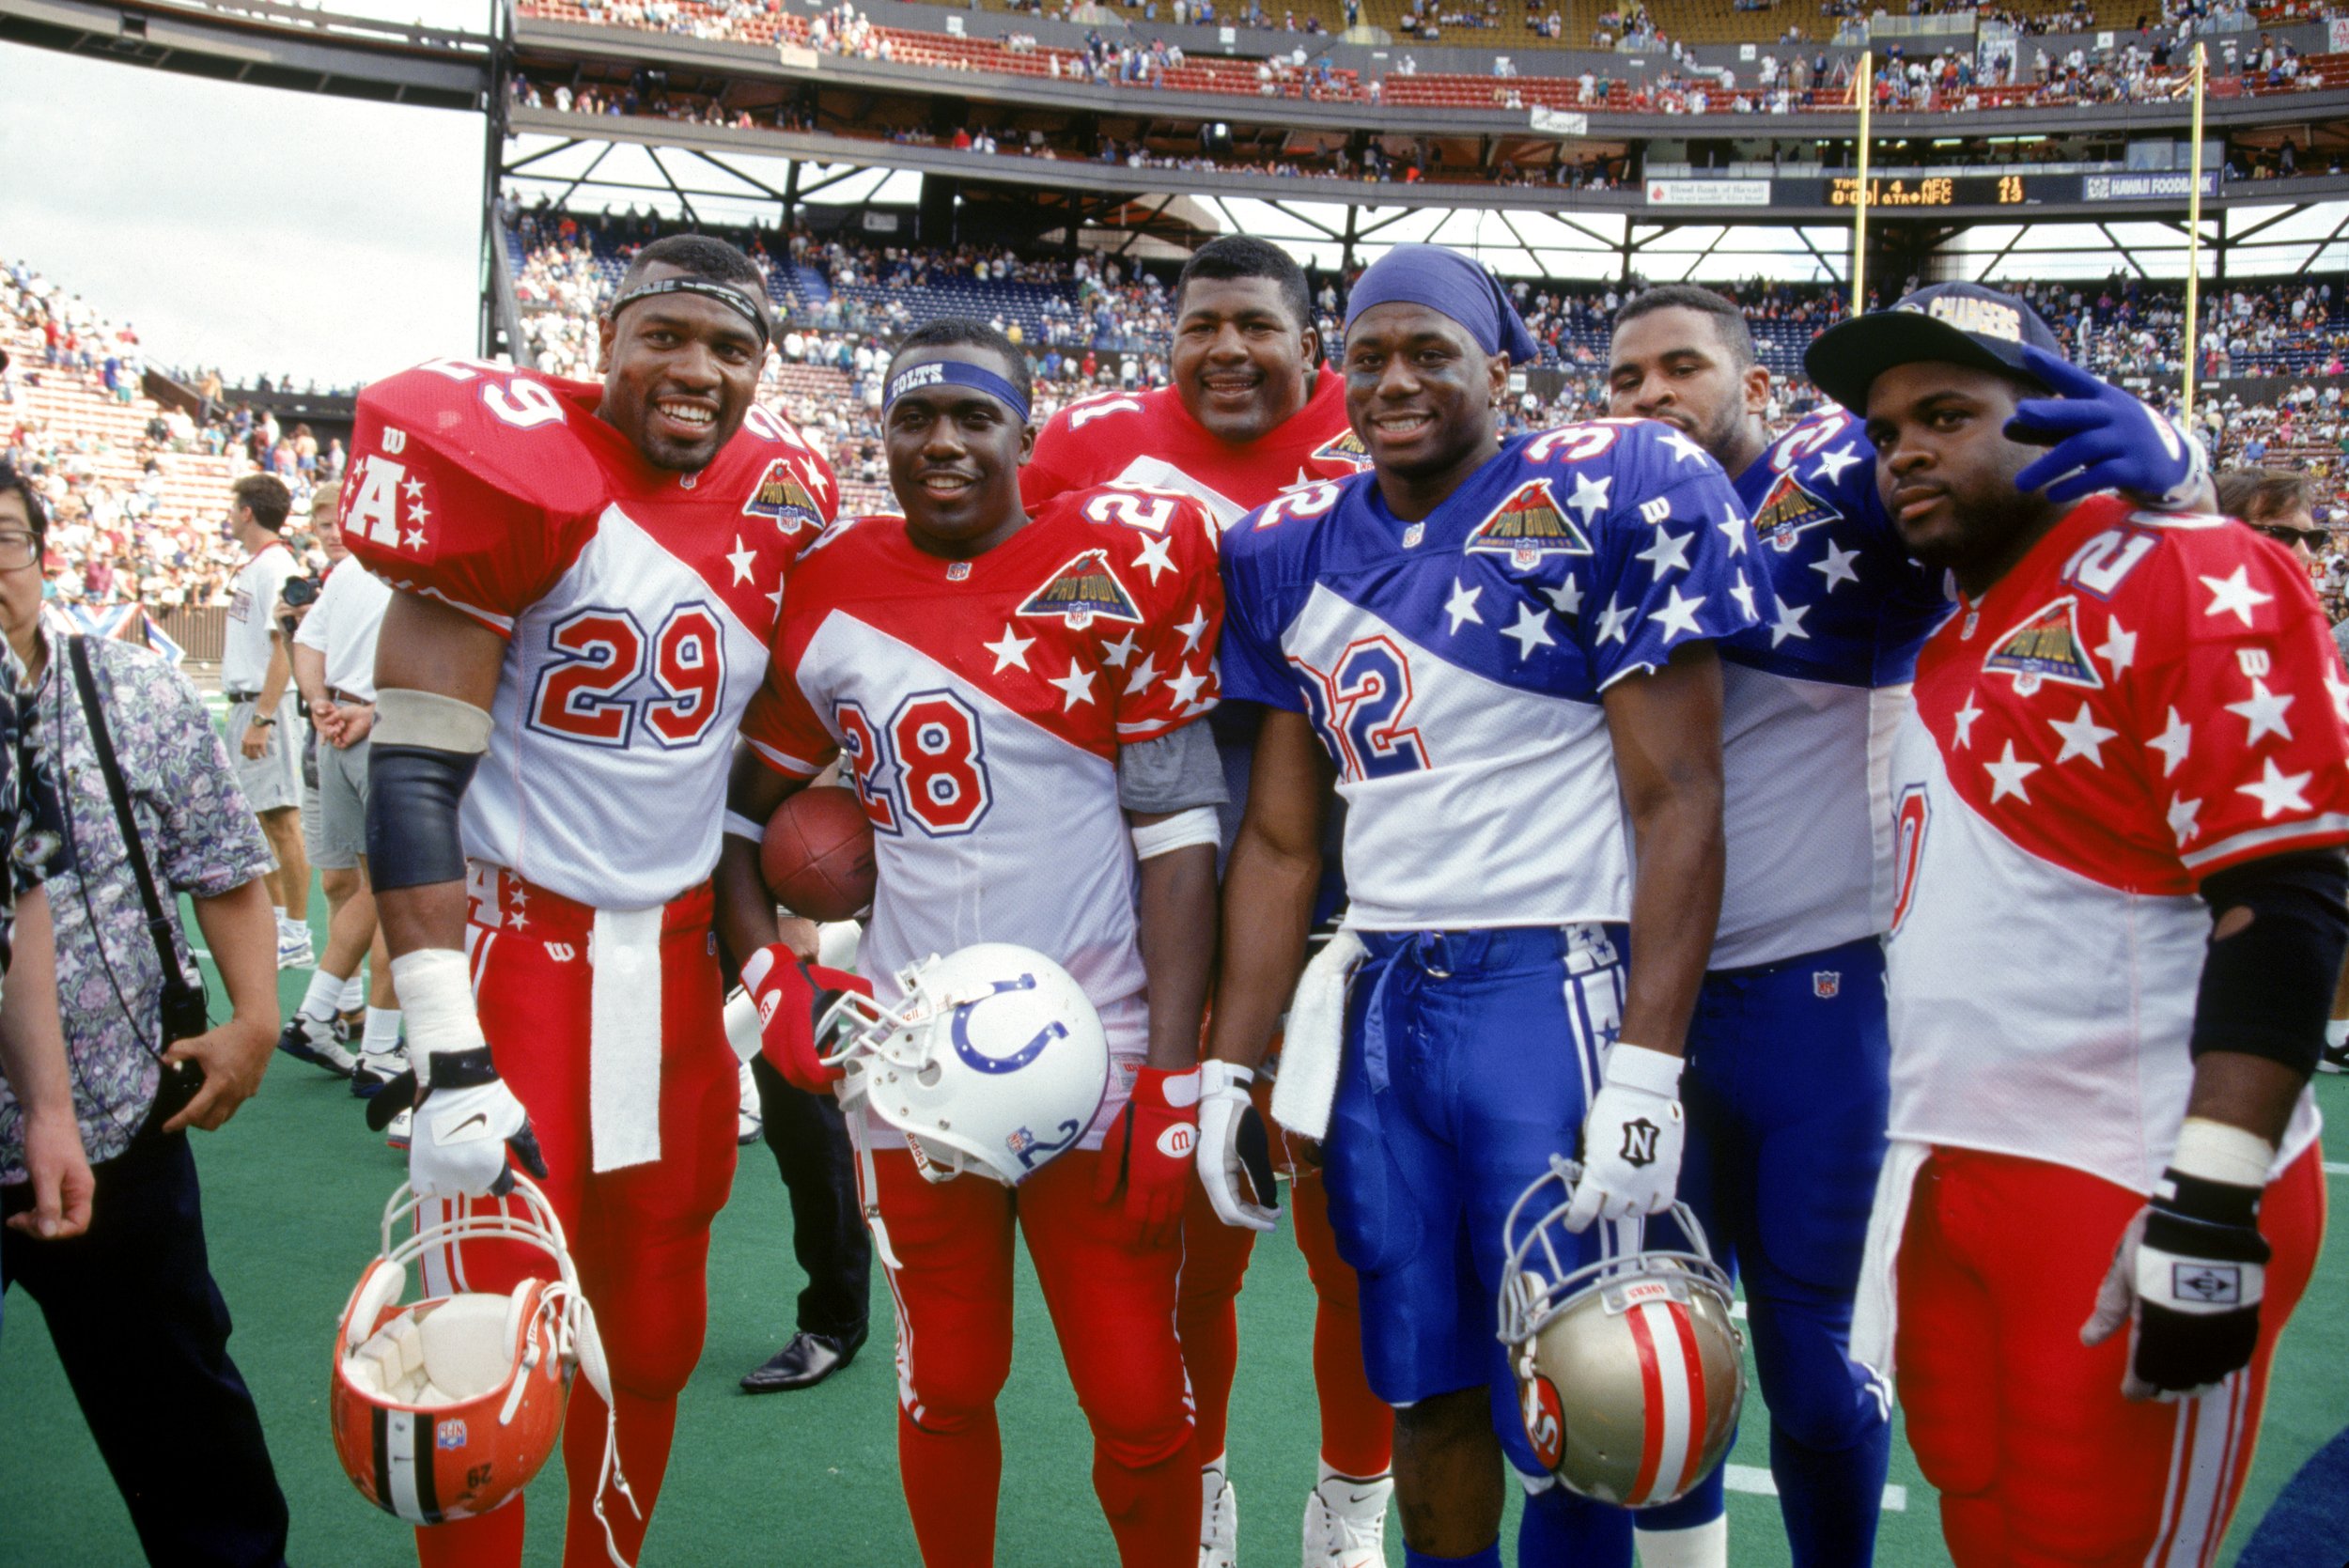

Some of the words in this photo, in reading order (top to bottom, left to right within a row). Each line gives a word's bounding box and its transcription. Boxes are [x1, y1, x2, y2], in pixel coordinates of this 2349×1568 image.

[1890, 180, 1903, 193] 4
[1921, 179, 1952, 190] AFC
[1999, 176, 2021, 189] 41
[2110, 179, 2150, 195] HAWAII
[1921, 191, 1952, 205] NFC
[2000, 189, 2022, 203] 13
[1929, 296, 2020, 342] CHARGERS
[893, 363, 943, 398] COLTS
[381, 426, 407, 454] W
[345, 454, 407, 549] A
[761, 482, 784, 505] PRO
[1639, 496, 1670, 524] W
[1489, 511, 1523, 537] PRO
[1517, 549, 1534, 561] NFL
[1047, 577, 1078, 601] PRO
[1080, 575, 1120, 604] BOWL
[1070, 612, 1088, 623] NFL
[525, 599, 725, 750] 29
[833, 688, 993, 838] 28
[1623, 1122, 1657, 1163] N
